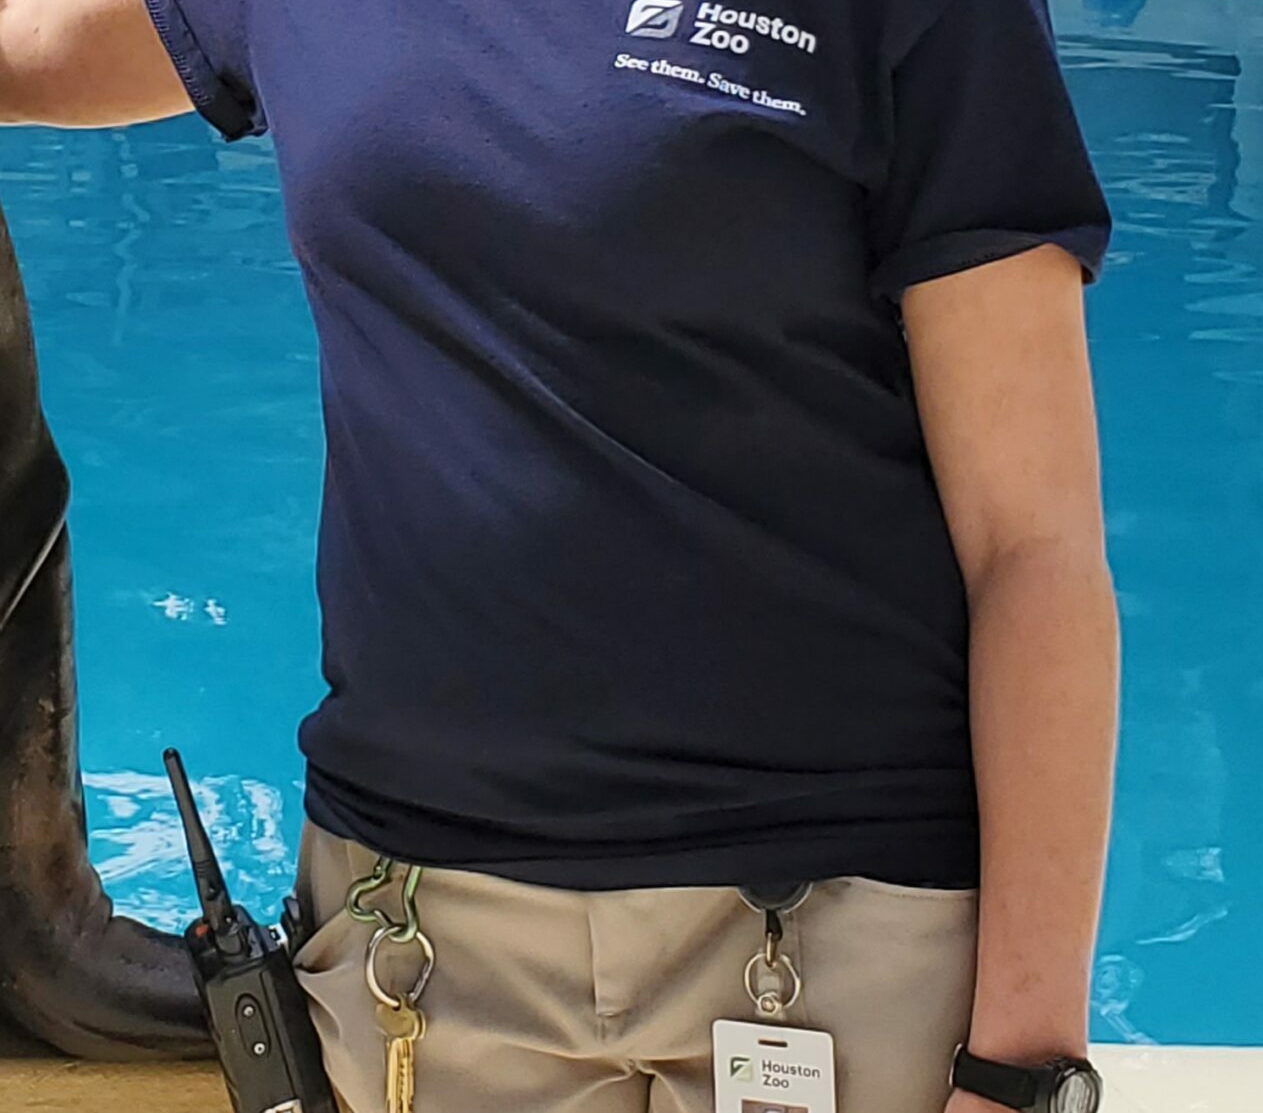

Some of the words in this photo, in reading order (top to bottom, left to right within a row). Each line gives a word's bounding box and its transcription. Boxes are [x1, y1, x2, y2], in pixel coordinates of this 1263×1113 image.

[689, 21, 750, 54] Zoo
[696, 1, 816, 54] Houston
[614, 53, 649, 71] See
[650, 60, 705, 84] them.
[707, 72, 750, 100] Save
[751, 89, 806, 116] them.
[761, 1059, 821, 1079] Houston
[762, 1074, 789, 1089] Zoo
